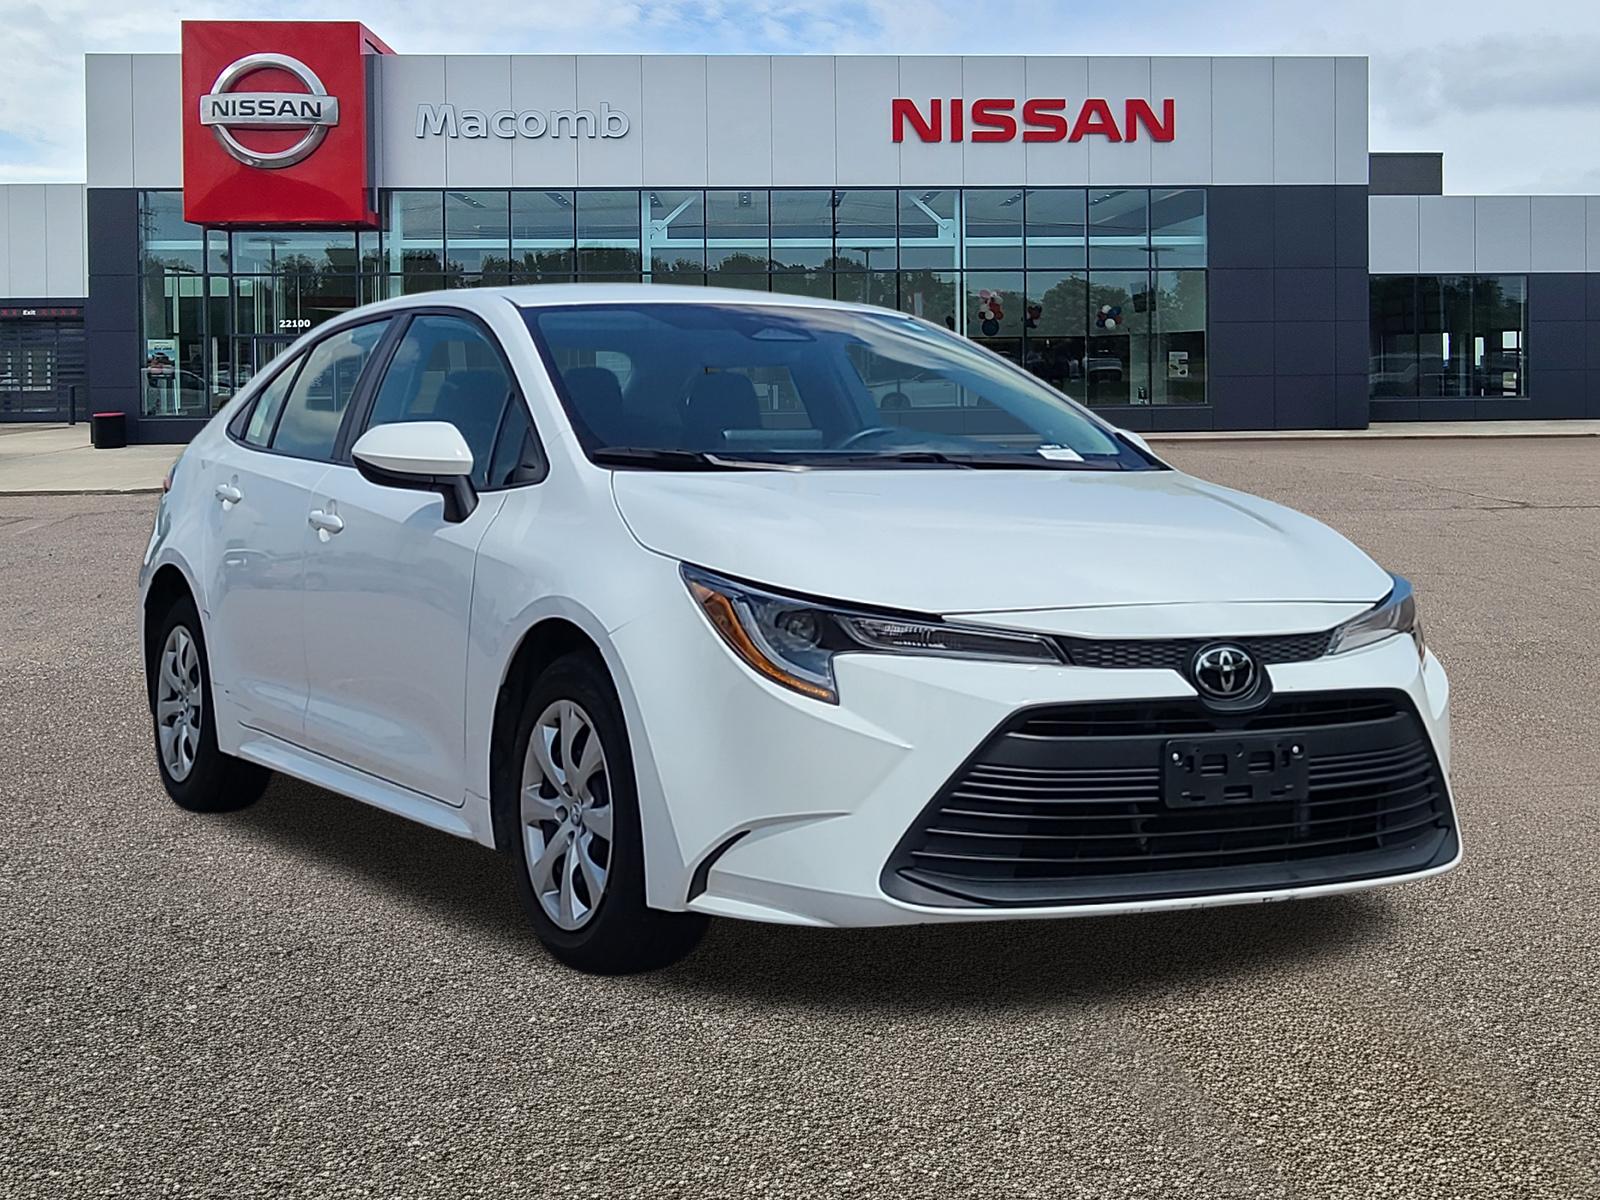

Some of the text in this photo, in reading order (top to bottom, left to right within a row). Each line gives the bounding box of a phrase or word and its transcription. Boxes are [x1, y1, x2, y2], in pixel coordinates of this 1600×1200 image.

[211, 100, 322, 118] NISSAN
[415, 102, 630, 139] Macomb
[890, 97, 1175, 143] NISSAN
[279, 319, 311, 328] 22100
